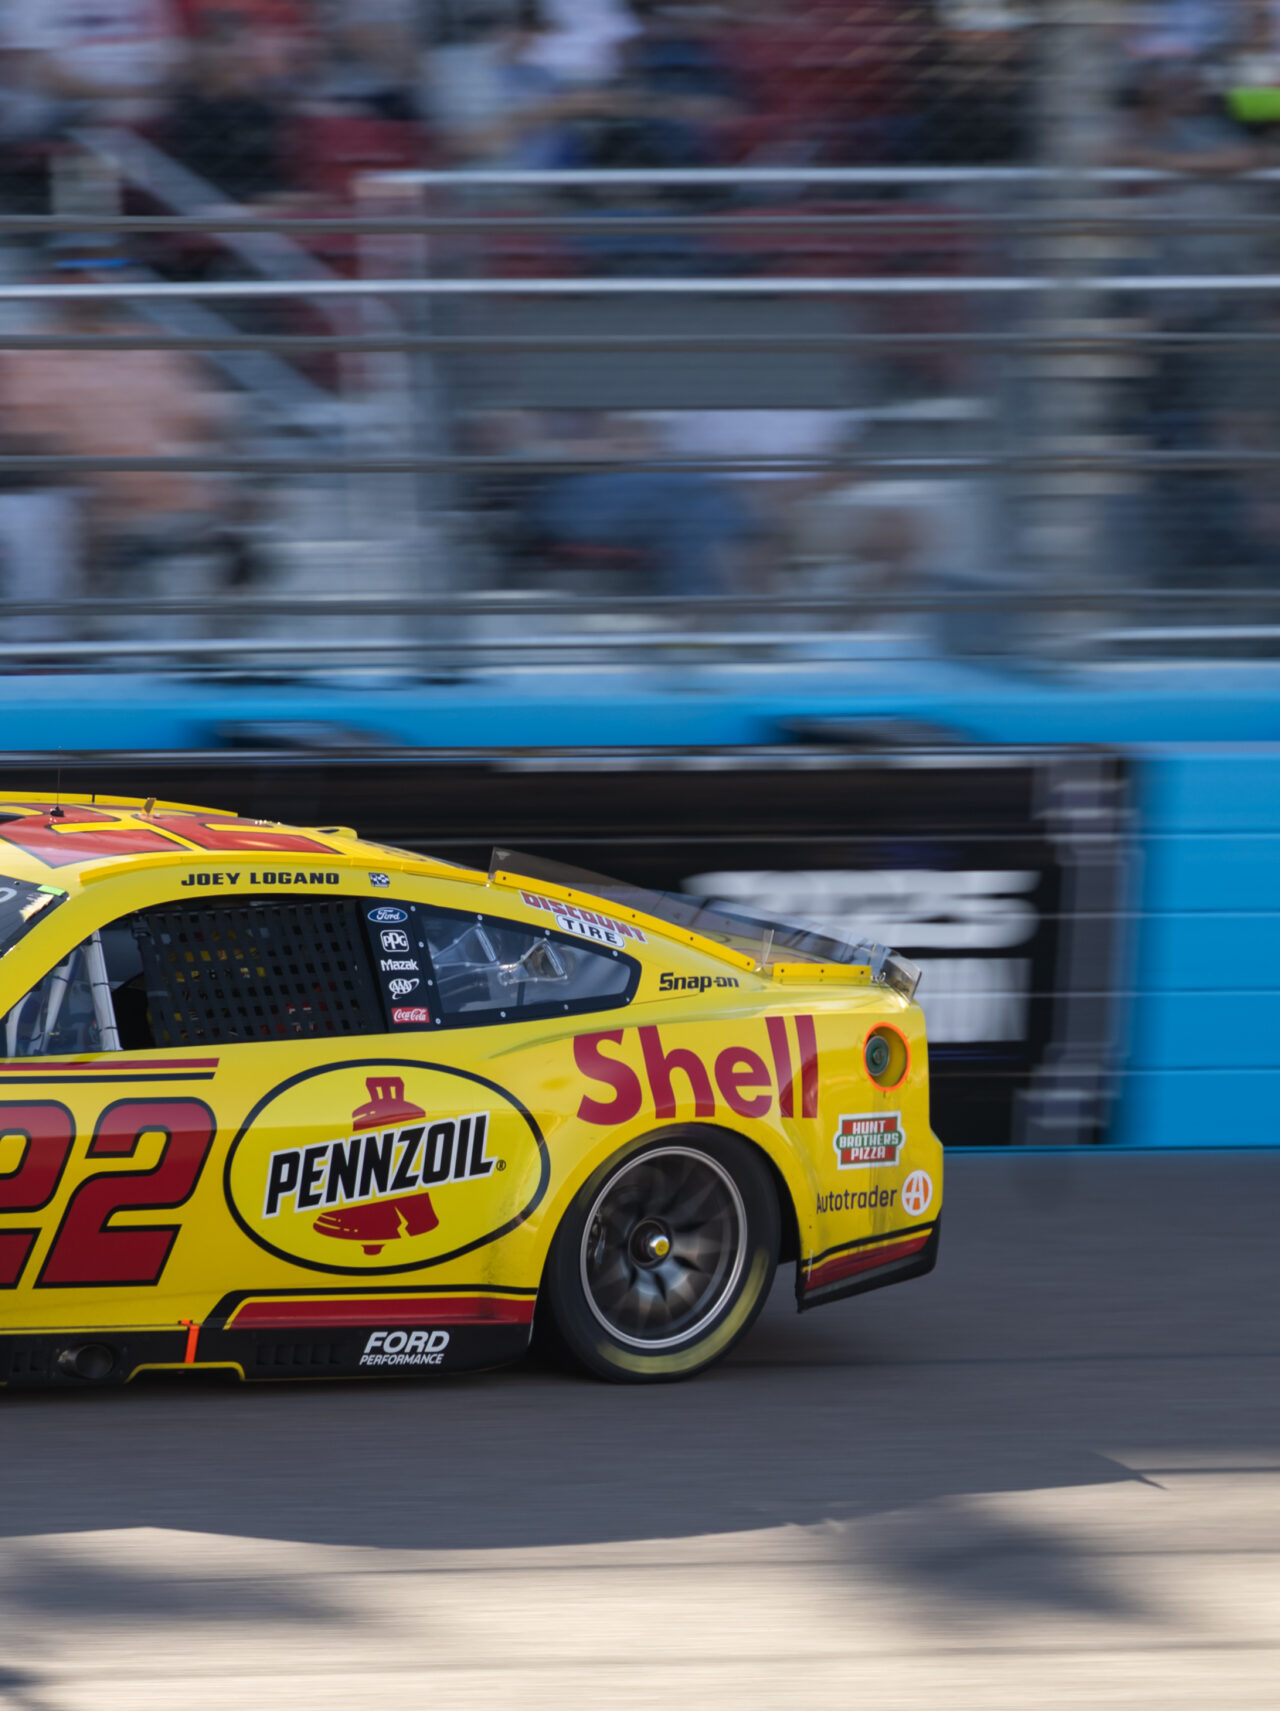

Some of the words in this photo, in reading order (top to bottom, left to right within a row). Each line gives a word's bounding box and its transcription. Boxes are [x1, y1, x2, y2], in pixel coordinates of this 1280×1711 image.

[181, 873, 240, 886] JOEY
[249, 871, 340, 885] LOGANO
[376, 910, 400, 920] Ford
[520, 891, 647, 943] DISCOUNT
[562, 917, 618, 944] TIRE
[384, 932, 408, 949] PPG
[380, 958, 419, 972] Mazak
[659, 972, 740, 993] Snap-on
[394, 1008, 426, 1022] Coca-Cola
[573, 1014, 819, 1126] Shell
[852, 1120, 886, 1135] HUNT
[839, 1132, 899, 1148] BROTHERS
[850, 1146, 886, 1161] PIZZA
[263, 1112, 497, 1218] PENNZOIL
[816, 1184, 898, 1215] Autotrader
[364, 1330, 450, 1354] FORD
[359, 1353, 444, 1366] PERFORMANCE
